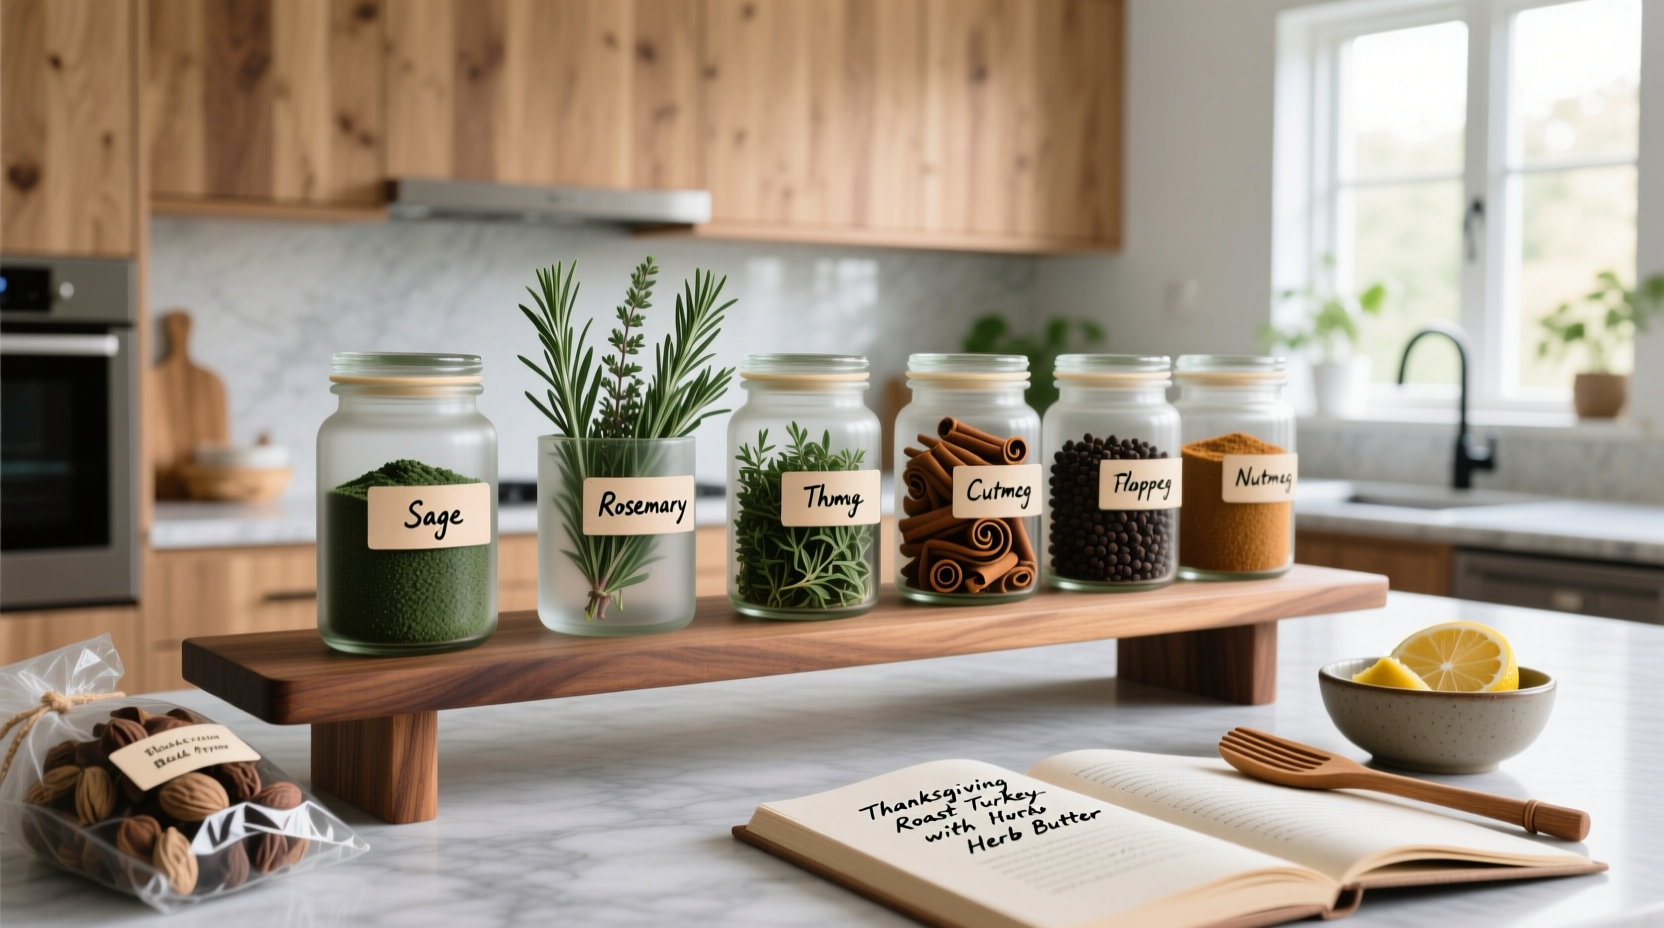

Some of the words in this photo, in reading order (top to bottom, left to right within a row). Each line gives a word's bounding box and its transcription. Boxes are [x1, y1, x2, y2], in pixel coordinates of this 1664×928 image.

[1235, 466, 1292, 493] Nutmeg
[404, 499, 463, 540] Sage
[598, 491, 688, 525] Rosemary
[859, 778, 1007, 820] Thanksgiving
[896, 803, 958, 833] Roast
[963, 790, 1046, 811] Turkey
[925, 818, 976, 842] with
[967, 826, 1023, 854] Herb
[1032, 809, 1102, 836] Butter
